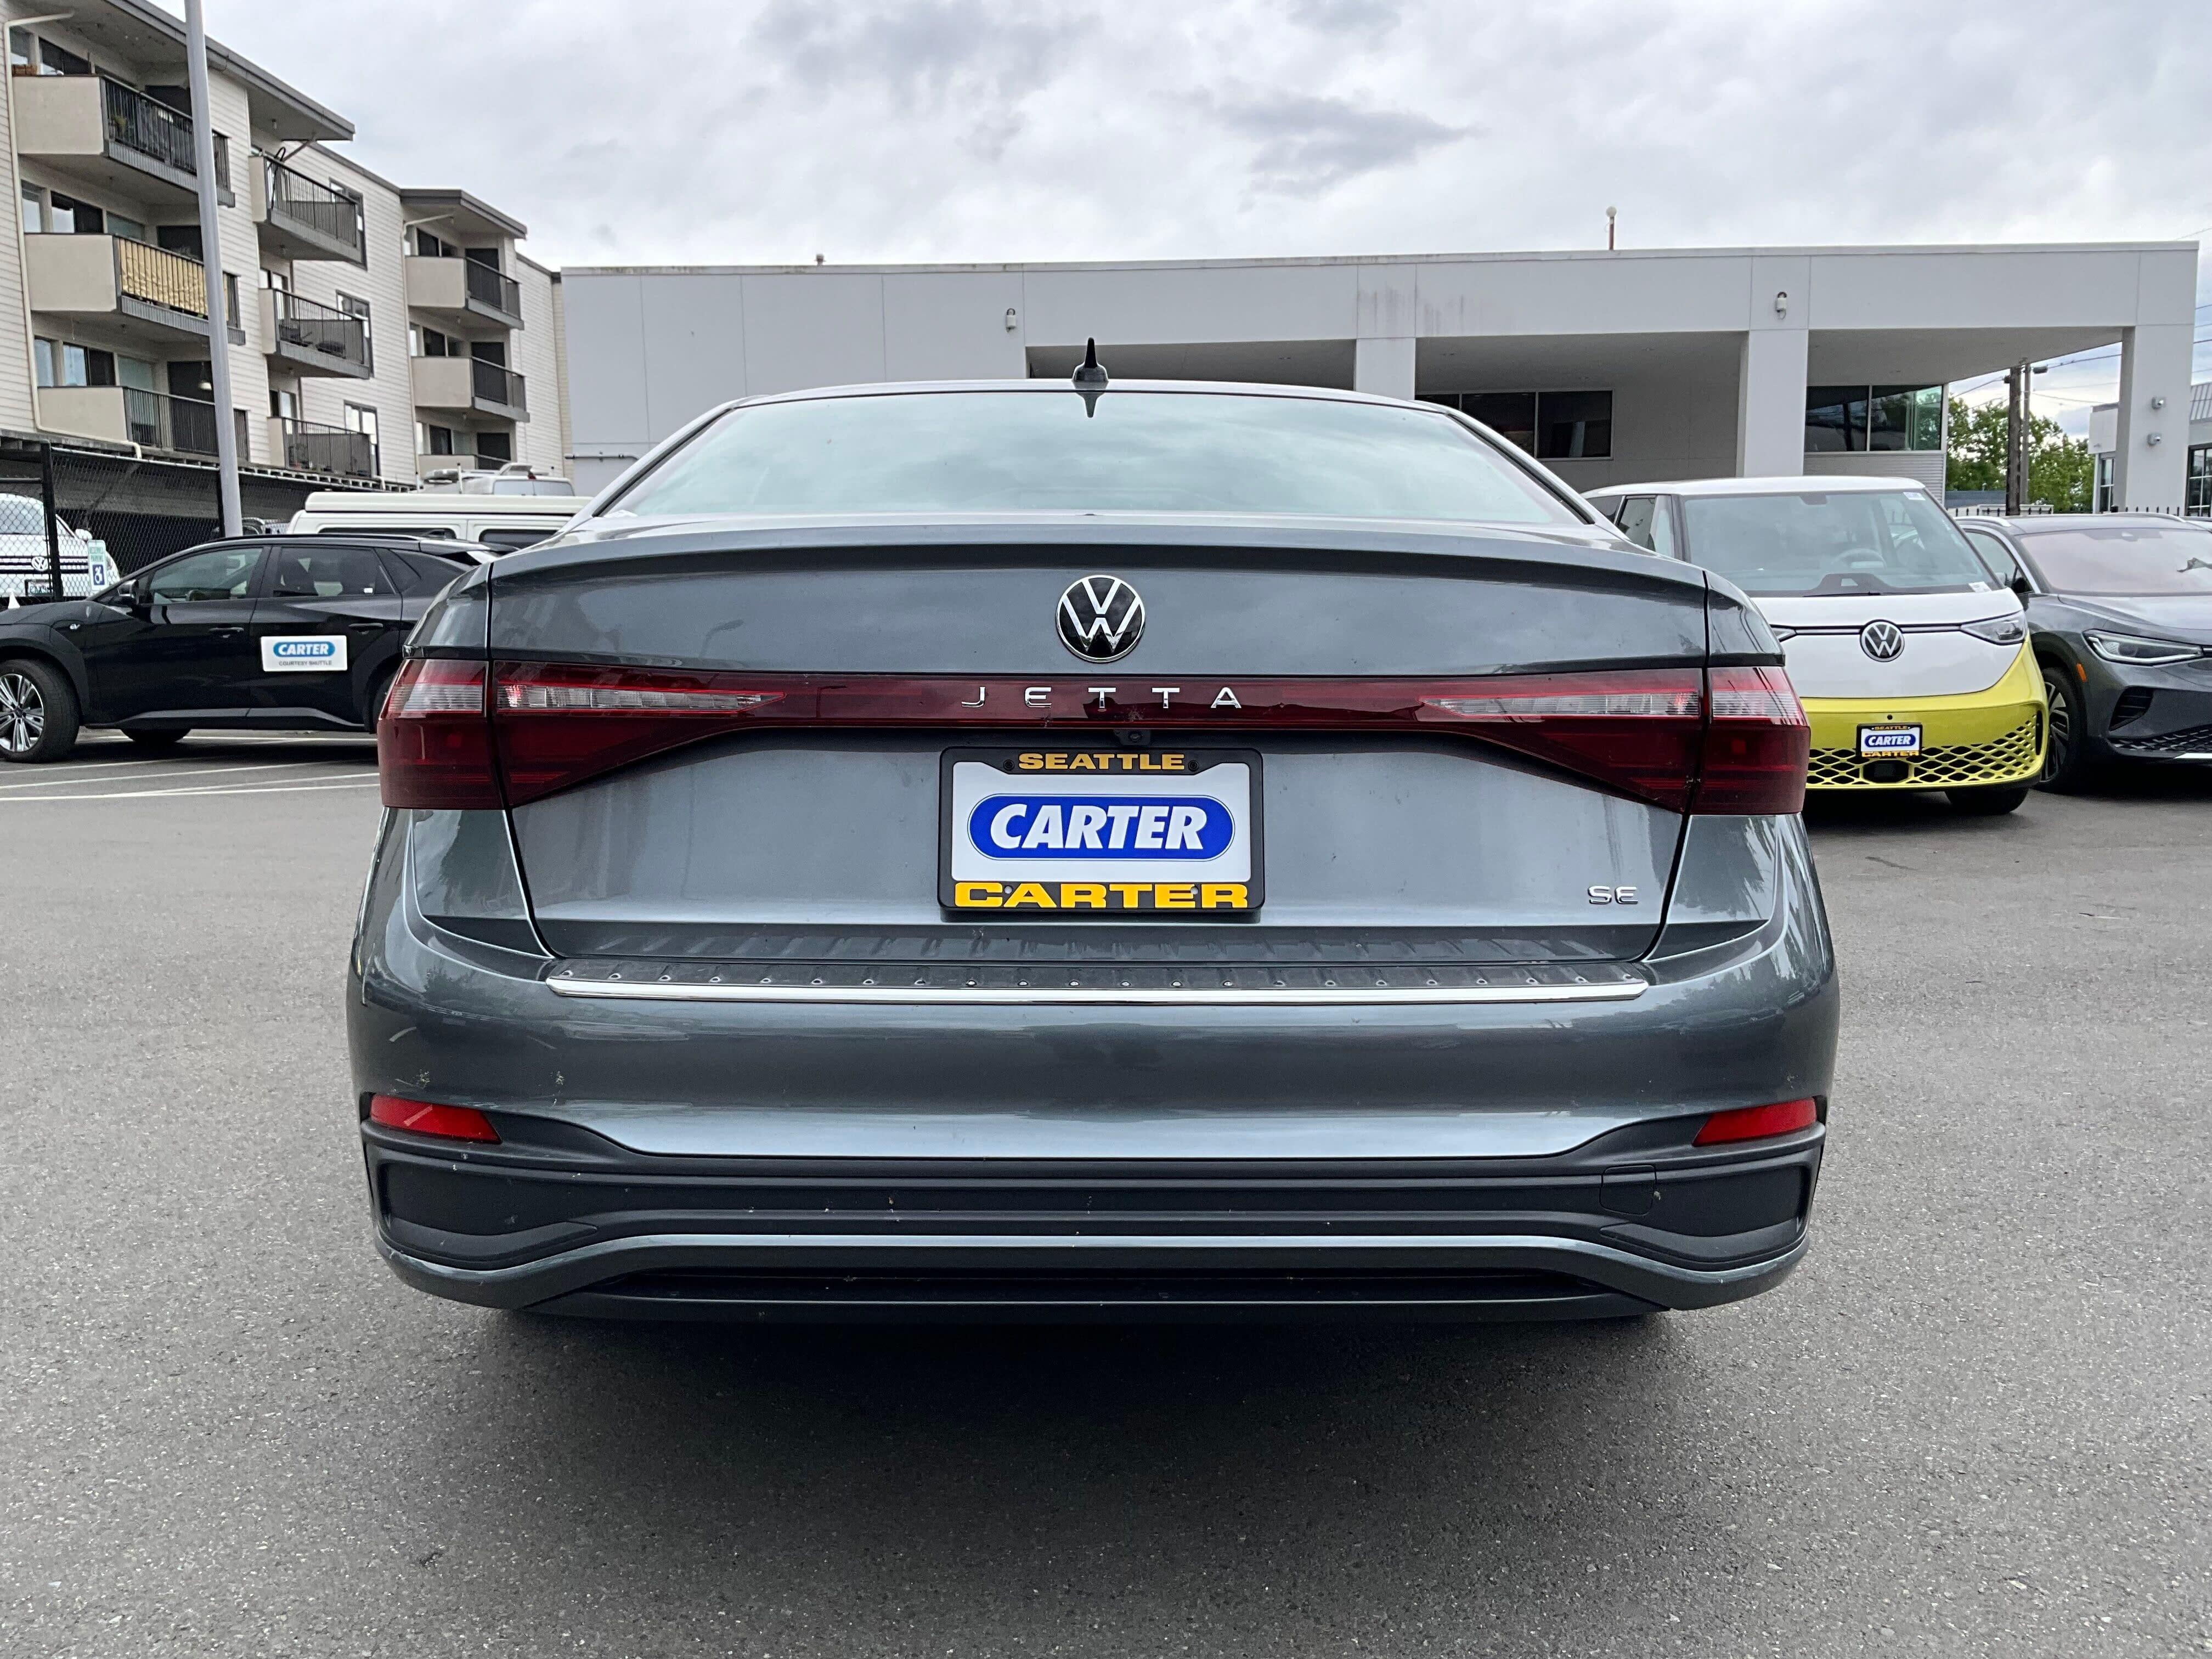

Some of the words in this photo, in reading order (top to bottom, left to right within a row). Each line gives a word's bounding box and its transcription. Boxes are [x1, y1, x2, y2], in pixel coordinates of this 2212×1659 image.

[1057, 575, 1145, 662] VW
[278, 644, 329, 656] CARTER
[1861, 620, 1903, 661] VW
[961, 686, 1242, 709] JETTA
[1868, 735, 1911, 746] CARTER
[1018, 752, 1185, 770] SEATTLE
[990, 803, 1208, 850] CARTER
[954, 881, 1248, 909] CARTER
[1588, 885, 1639, 905] SE
